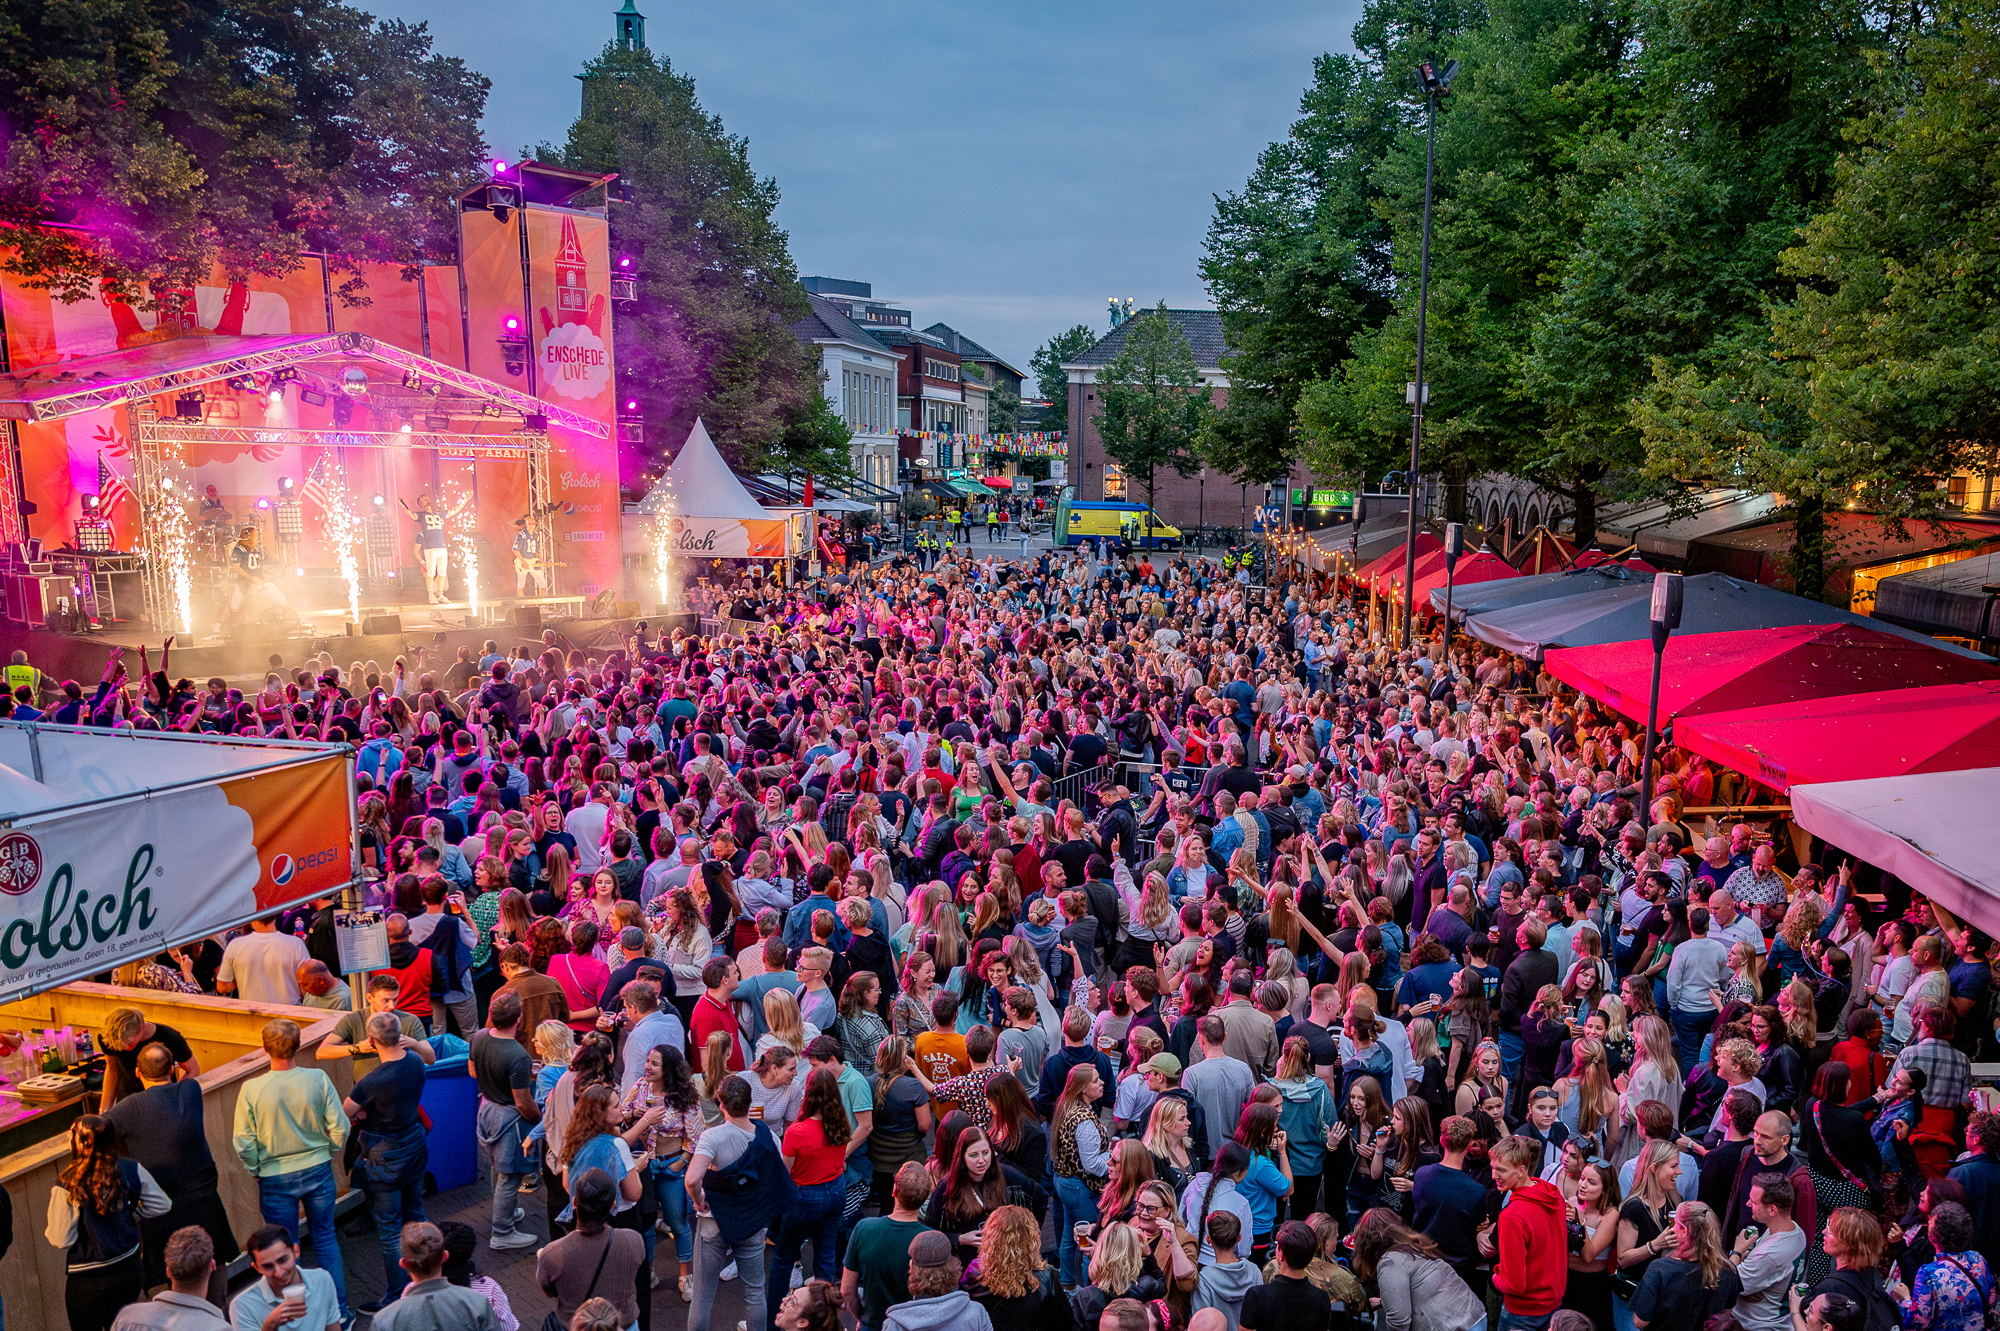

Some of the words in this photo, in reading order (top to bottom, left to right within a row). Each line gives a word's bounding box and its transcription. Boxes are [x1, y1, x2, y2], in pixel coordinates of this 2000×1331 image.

[547, 346, 605, 366] ENSCHEDE
[562, 363, 589, 381] LIVE
[560, 471, 602, 491] Grolsch
[576, 503, 602, 514] pepsi
[1254, 508, 1280, 523] WC
[425, 515, 442, 531] 99
[526, 539, 537, 554] 14
[670, 529, 717, 551] olsch
[1172, 778, 1188, 789] CREW
[296, 843, 339, 876] pepsi
[0, 843, 159, 971] olsch
[84, 948, 105, 962] Geen
[119, 938, 138, 953] geen
[923, 1052, 957, 1066] SALTY
